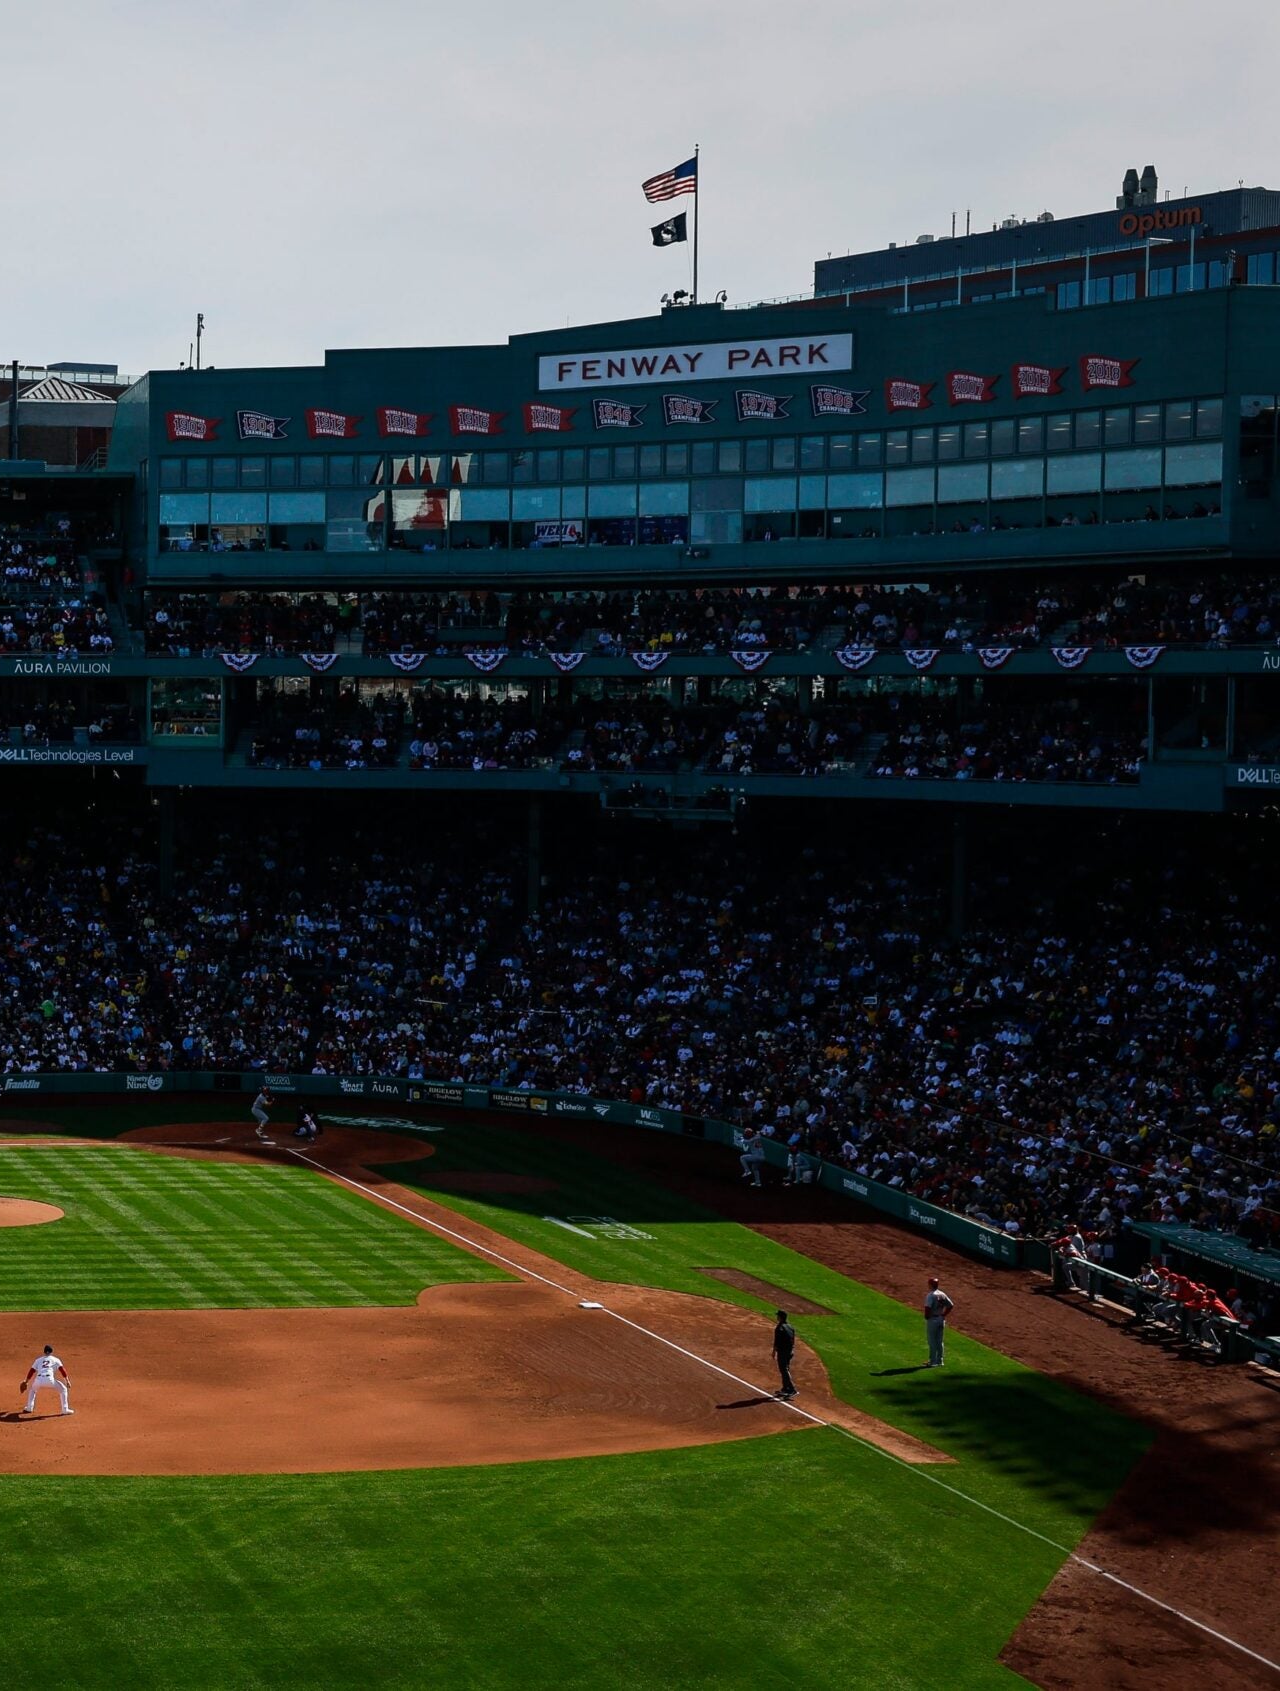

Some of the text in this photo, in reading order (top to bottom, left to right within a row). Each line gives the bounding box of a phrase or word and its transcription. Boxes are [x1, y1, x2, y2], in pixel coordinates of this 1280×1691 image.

[1119, 206, 1201, 238] Optum
[558, 343, 828, 382] FENWAY PARK
[1088, 363, 1120, 380] 2018
[953, 380, 984, 394] 2007
[1019, 372, 1050, 388] 2013
[891, 387, 920, 402] 2004
[315, 417, 346, 431] 1912
[387, 415, 417, 430] 1915
[460, 414, 489, 428] 1916
[532, 411, 561, 425] 1918
[174, 419, 206, 434] 1903
[57, 663, 111, 673] PAVILION
[105, 749, 134, 761] Level
[126, 1074, 148, 1082] Ninety
[126, 1080, 147, 1089] Nine
[42, 1360, 50, 1368] 2
